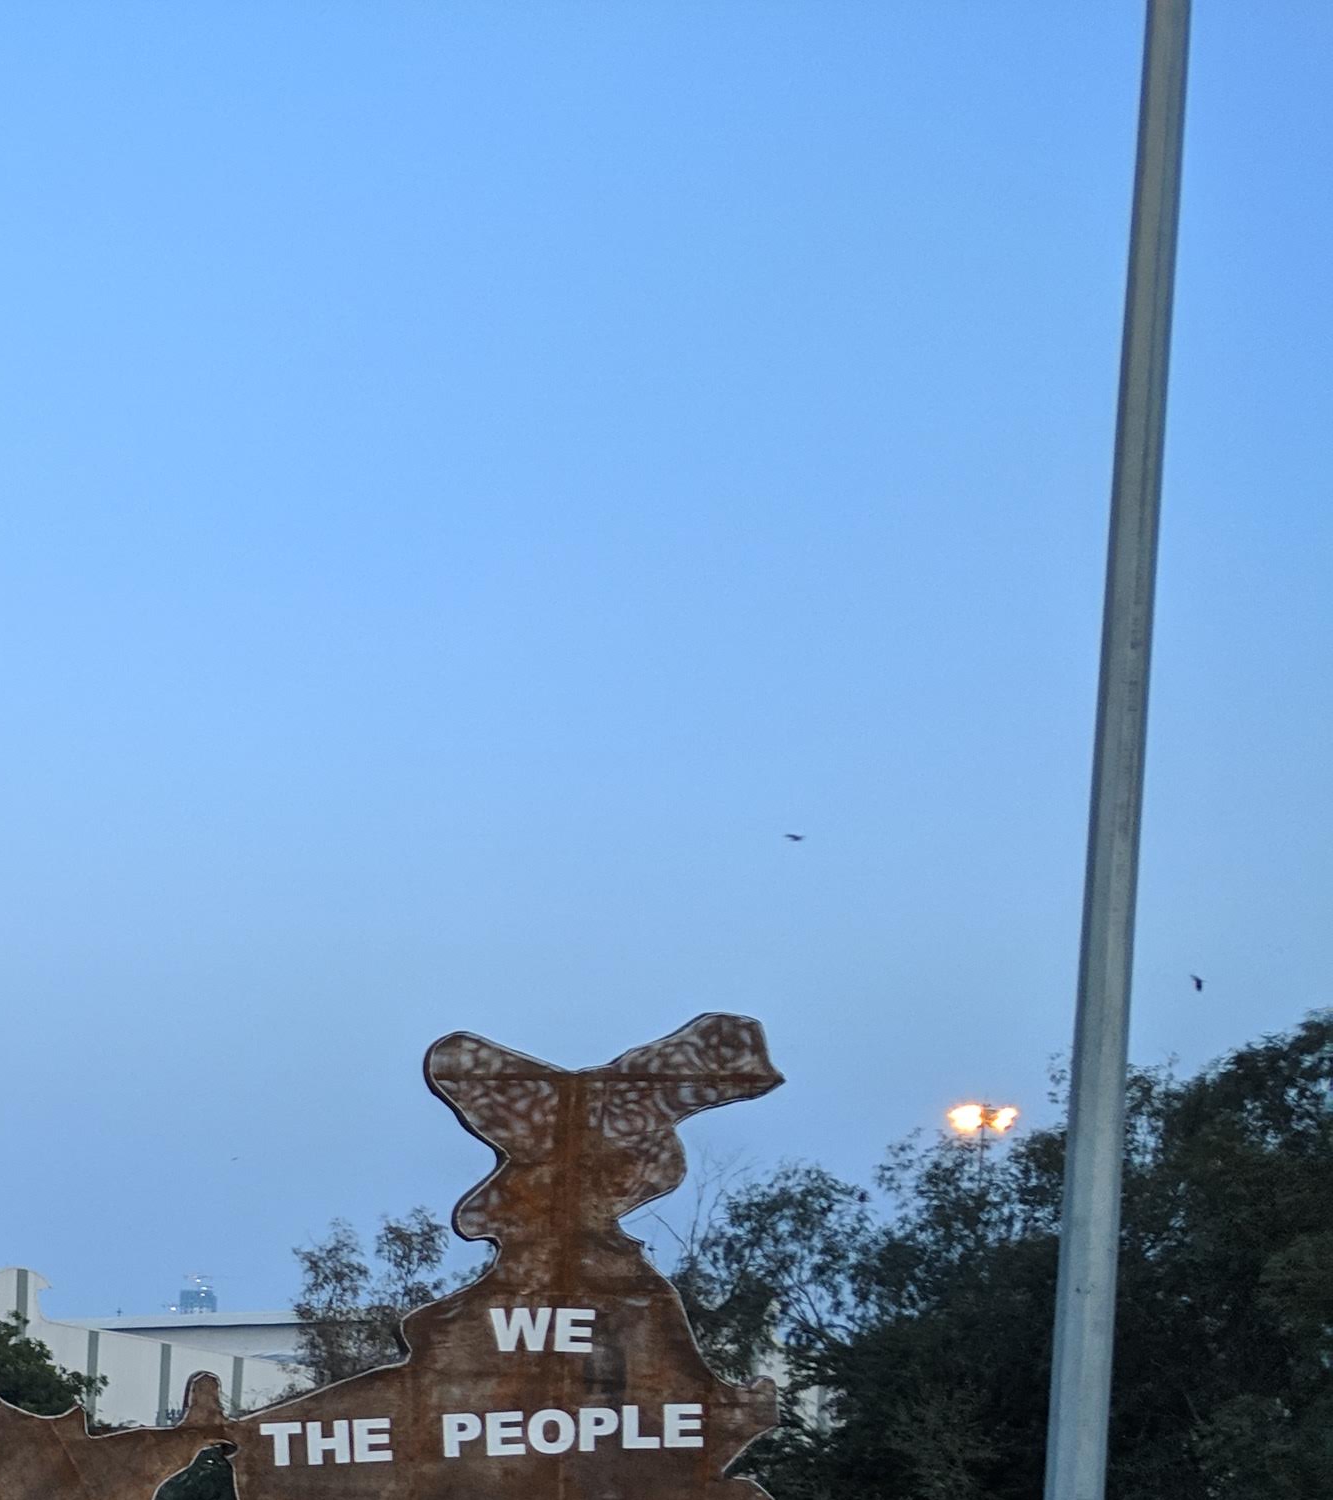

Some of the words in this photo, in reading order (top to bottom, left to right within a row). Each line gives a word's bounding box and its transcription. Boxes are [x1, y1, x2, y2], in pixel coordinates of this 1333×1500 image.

[490, 1307, 597, 1354] WE
[259, 1418, 393, 1466] THE
[443, 1403, 704, 1457] PEOPLE
